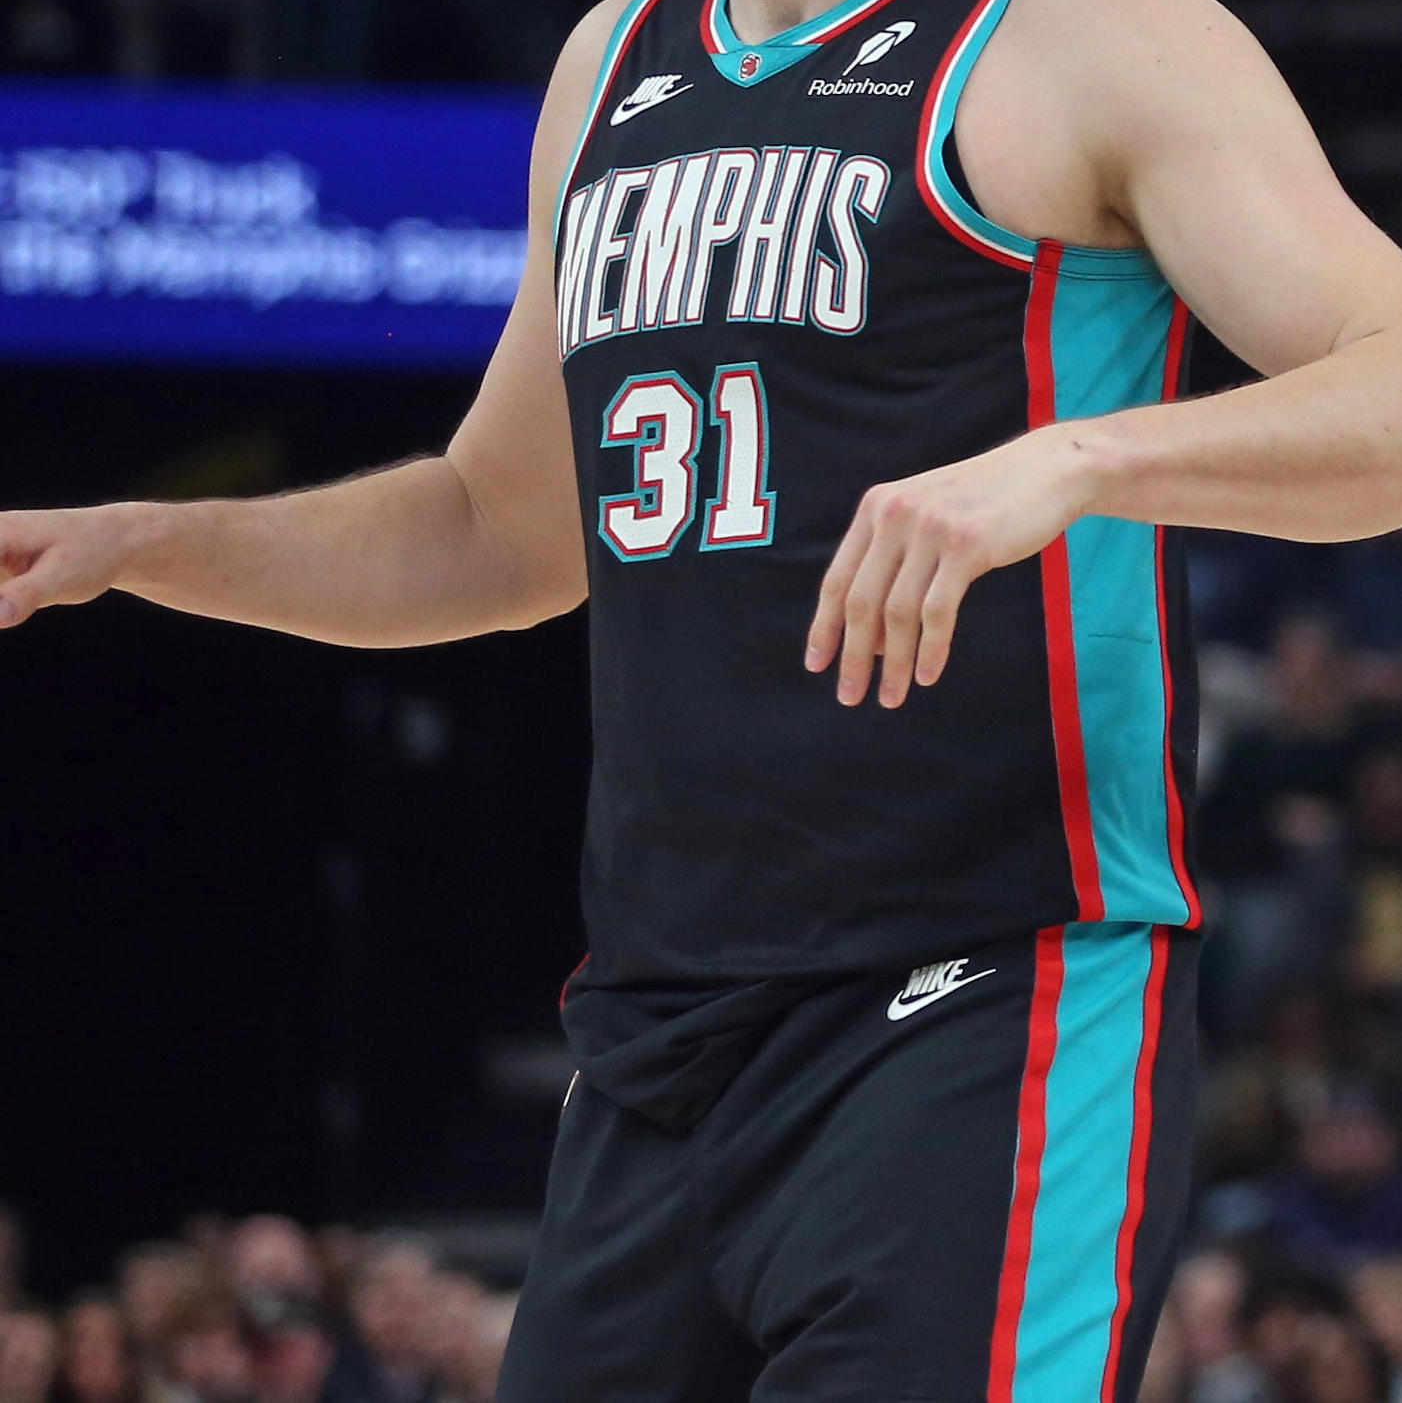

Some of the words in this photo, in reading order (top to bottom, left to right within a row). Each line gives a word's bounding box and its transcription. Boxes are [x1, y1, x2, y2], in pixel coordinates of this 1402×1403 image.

[624, 74, 683, 106] NIKE
[807, 78, 915, 97] Robinhood
[557, 145, 893, 365] MEMPHIS
[598, 361, 777, 564] 31
[900, 958, 970, 1000] NIKE
